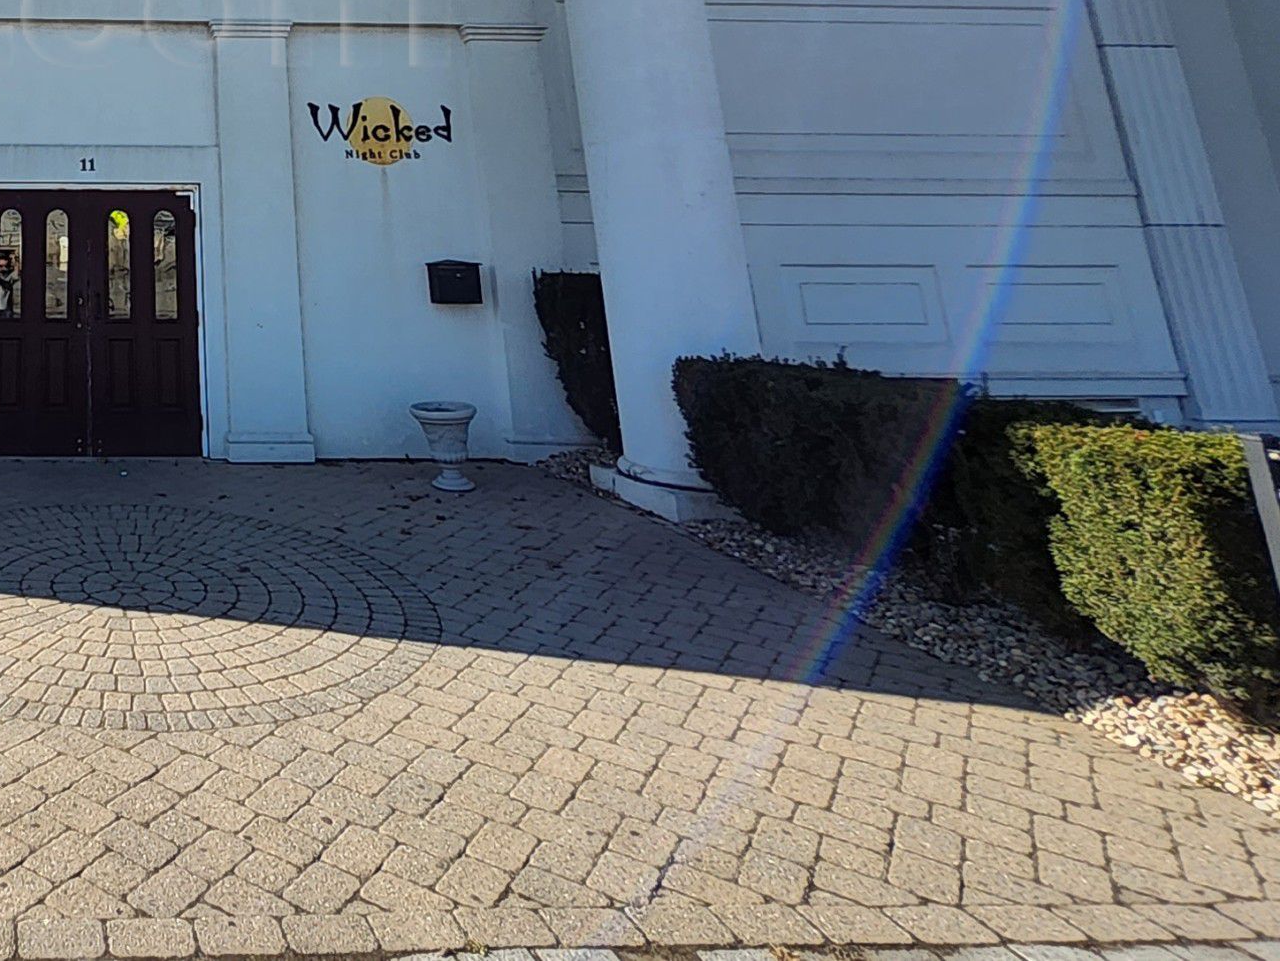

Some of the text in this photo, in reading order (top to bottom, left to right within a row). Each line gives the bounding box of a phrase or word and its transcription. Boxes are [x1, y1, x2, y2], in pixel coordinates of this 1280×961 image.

[307, 102, 452, 143] Wicked
[344, 149, 421, 160] Night Club
[80, 157, 96, 172] 11
